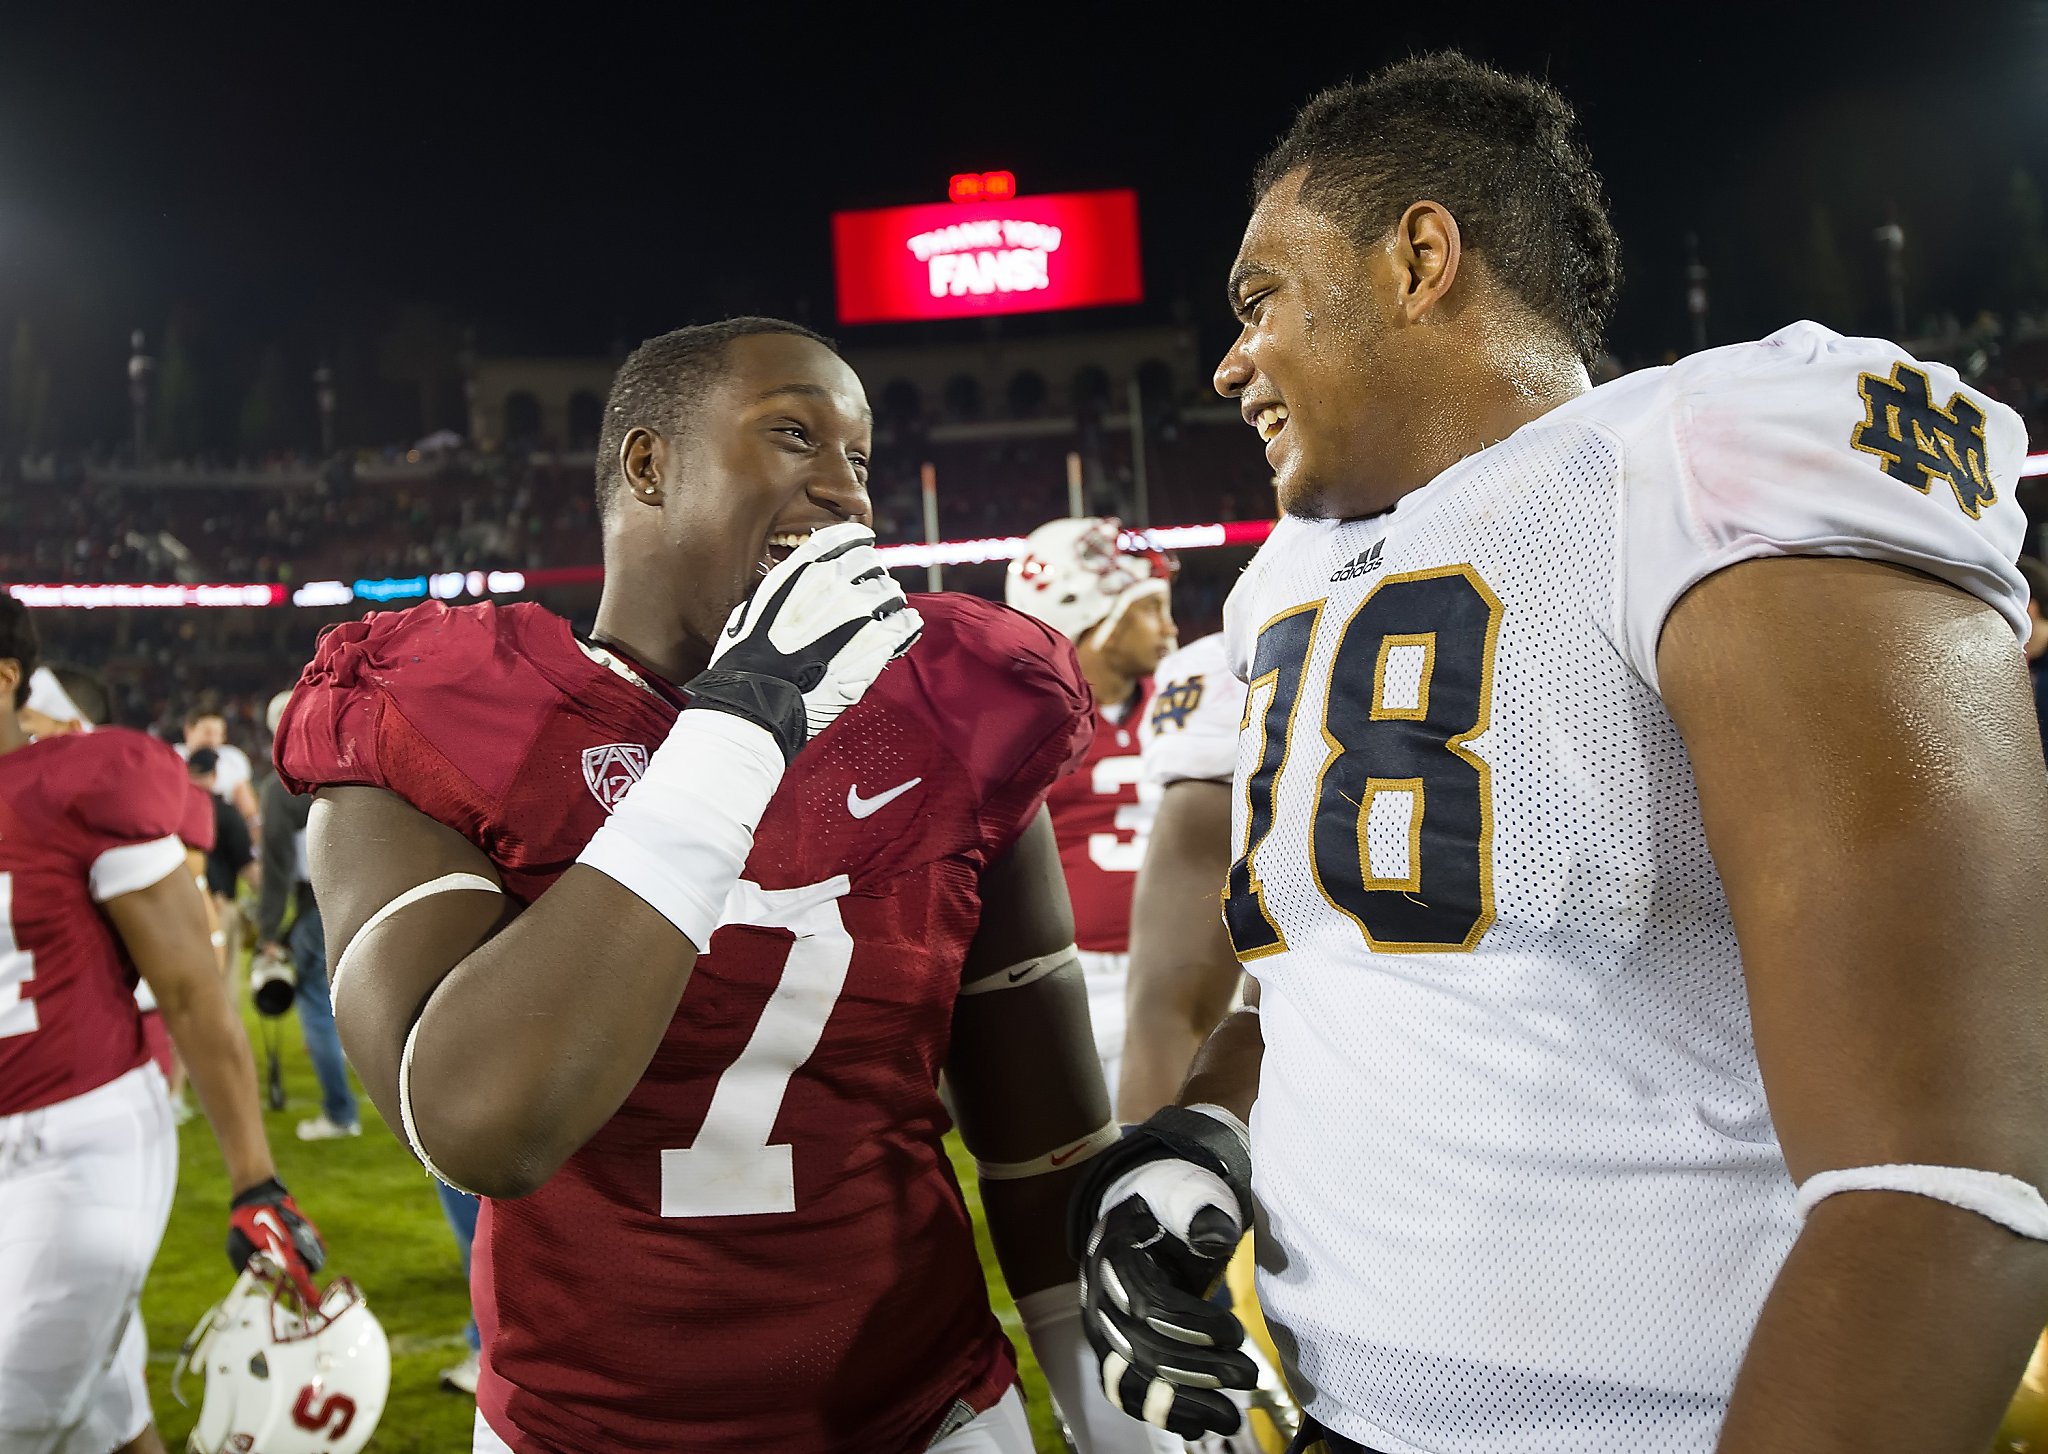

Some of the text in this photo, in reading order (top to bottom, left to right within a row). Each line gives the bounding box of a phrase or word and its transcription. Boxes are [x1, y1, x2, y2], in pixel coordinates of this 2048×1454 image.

[1330, 557, 1384, 582] adidas
[587, 747, 643, 791] PAC
[1221, 563, 1505, 963] 78
[602, 775, 633, 803] 12
